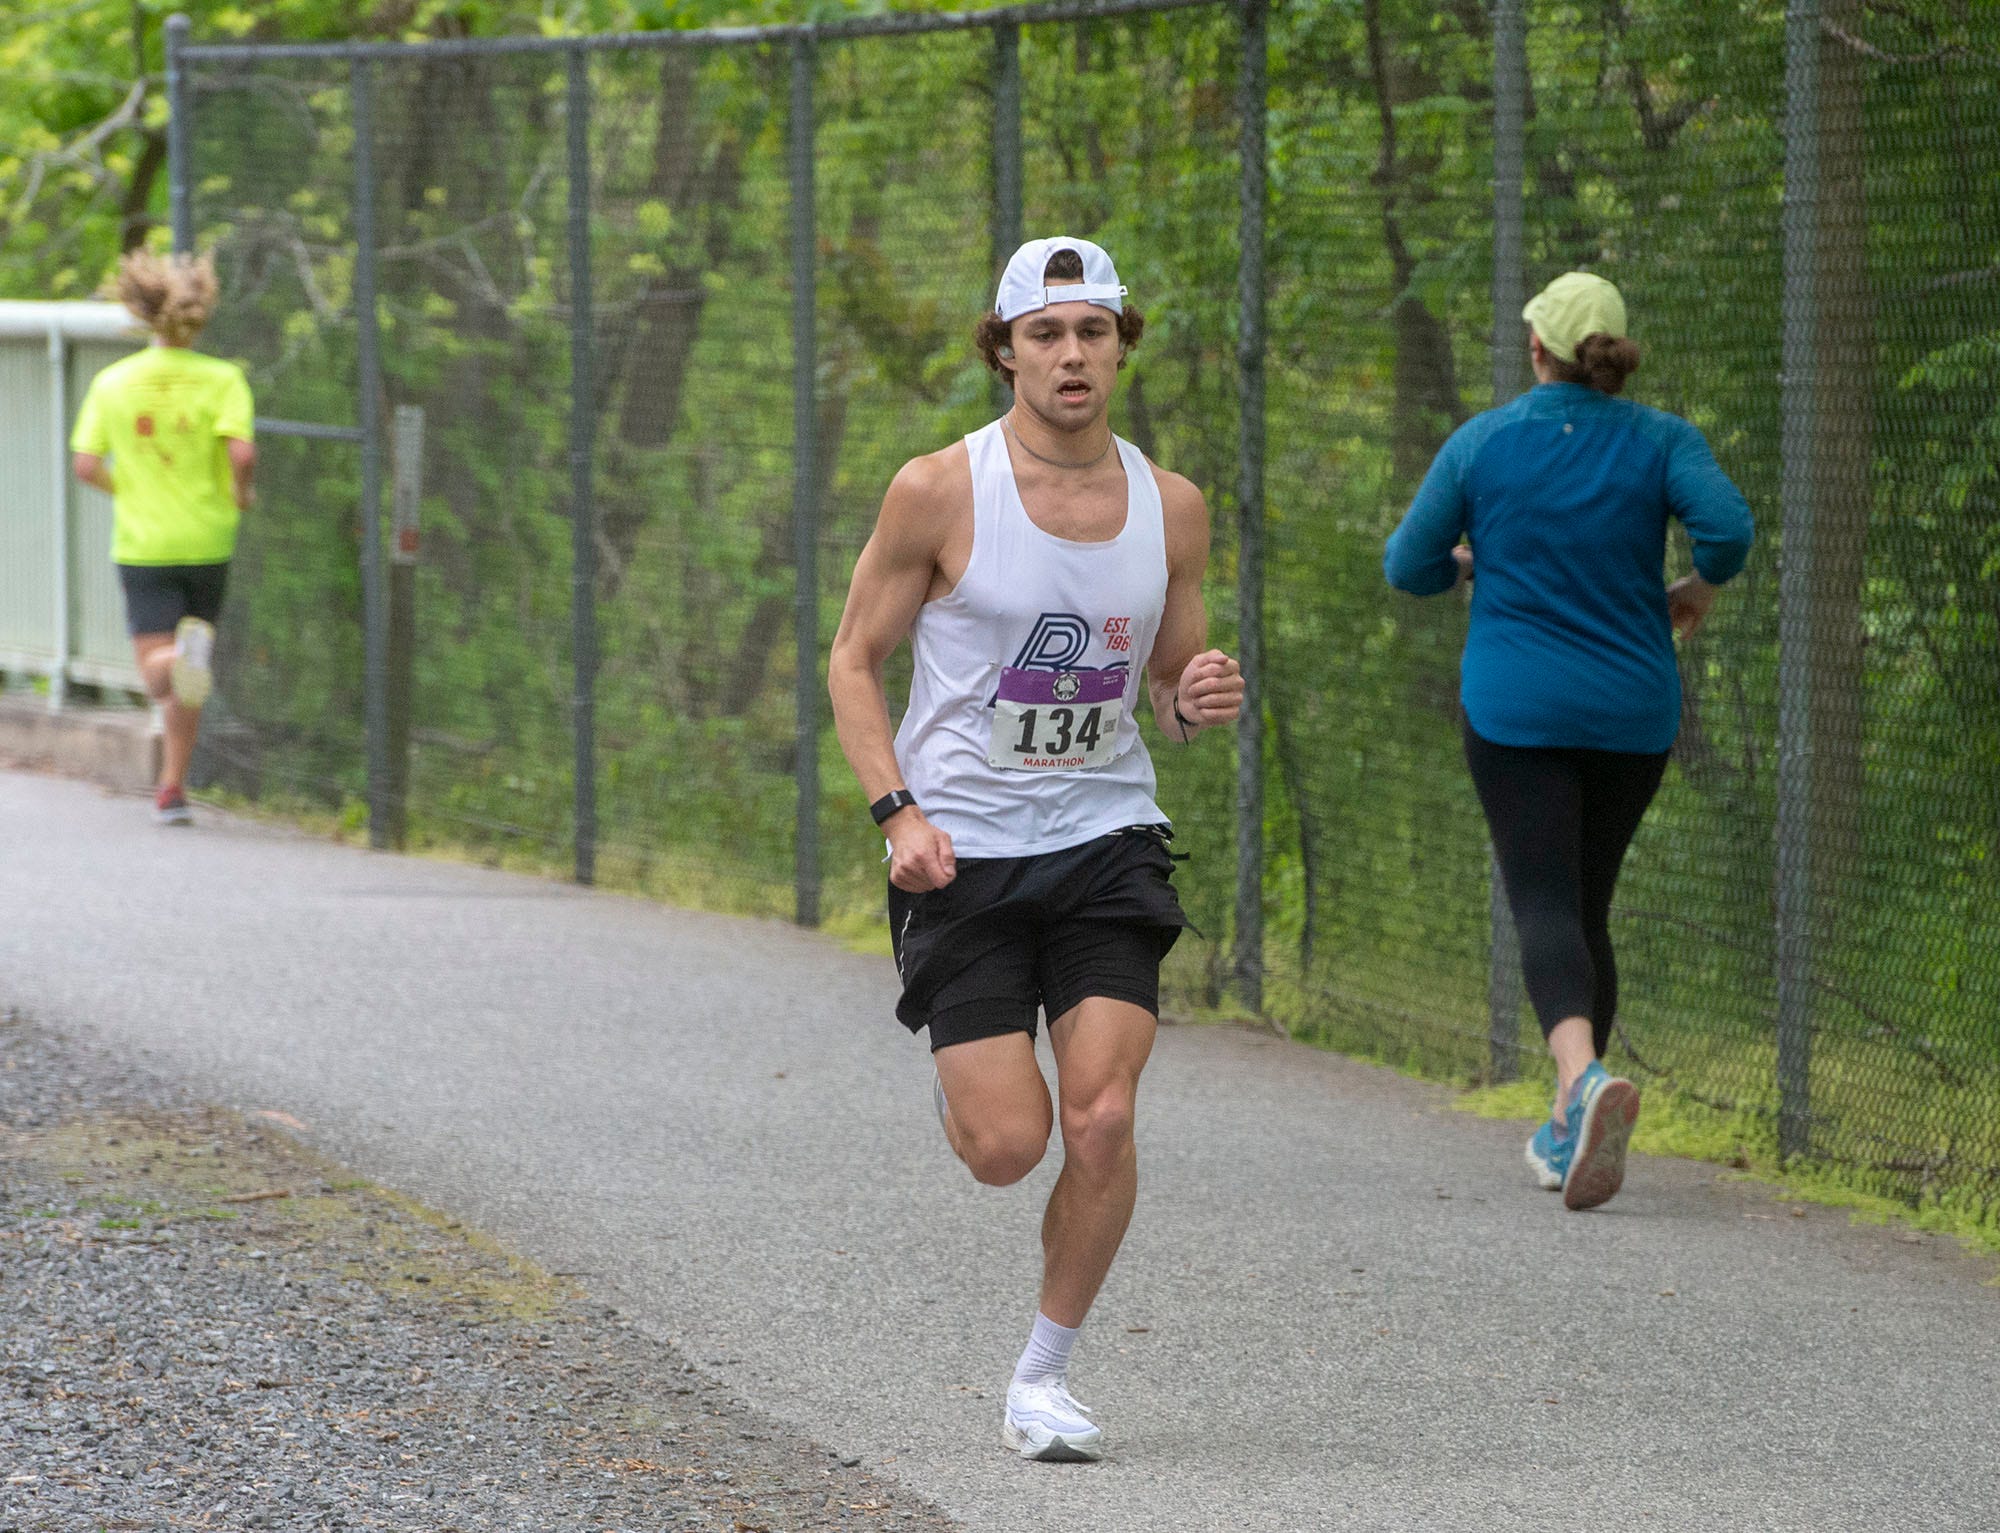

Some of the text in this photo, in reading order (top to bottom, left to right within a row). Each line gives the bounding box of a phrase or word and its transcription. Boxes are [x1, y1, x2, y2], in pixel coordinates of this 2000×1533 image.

[1103, 617, 1130, 634] EST.
[1106, 634, 1132, 652] 196
[1014, 707, 1102, 755] 134
[1023, 756, 1085, 768] MARATHON
